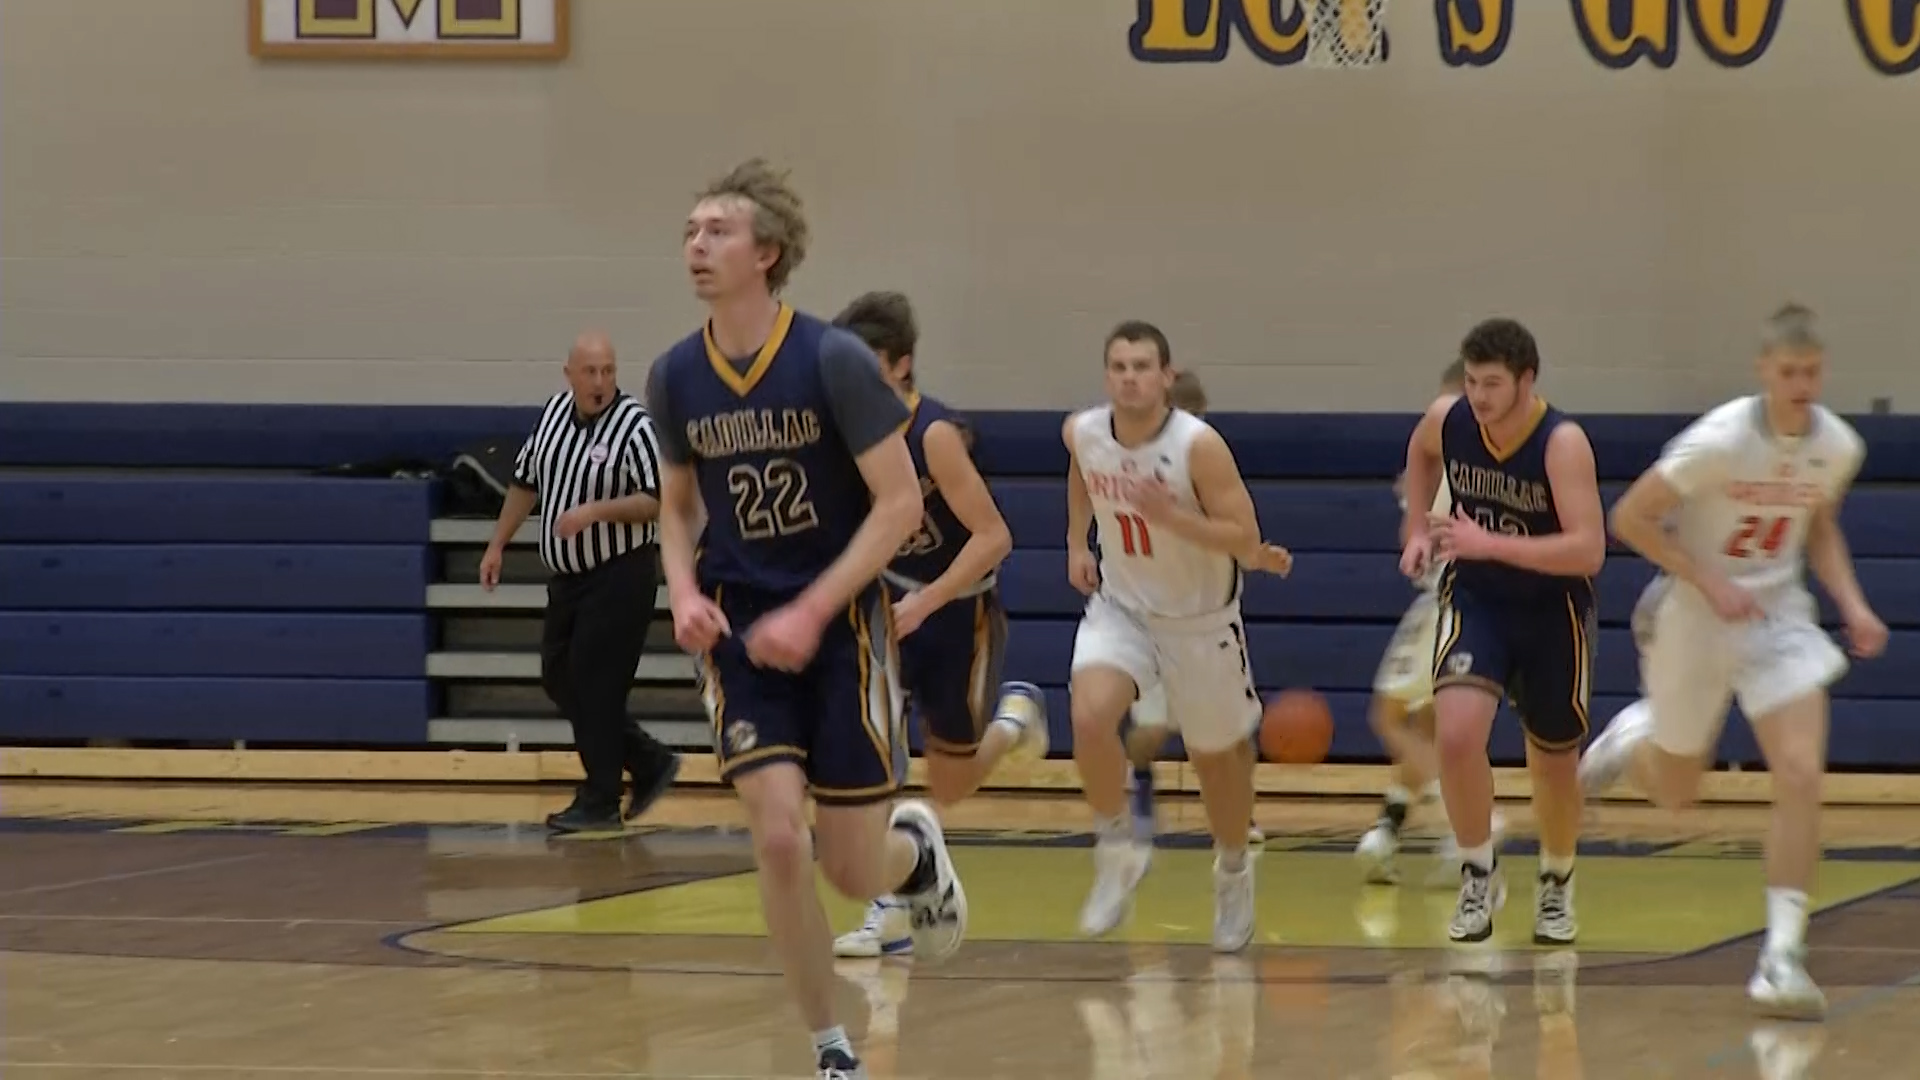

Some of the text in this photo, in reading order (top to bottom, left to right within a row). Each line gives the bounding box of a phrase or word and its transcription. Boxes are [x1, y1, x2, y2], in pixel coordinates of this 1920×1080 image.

[686, 408, 821, 458] CADILLAC
[728, 458, 819, 539] 22
[1449, 458, 1548, 513] CADILLAC
[1114, 511, 1153, 558] 11
[1722, 516, 1791, 559] 24
